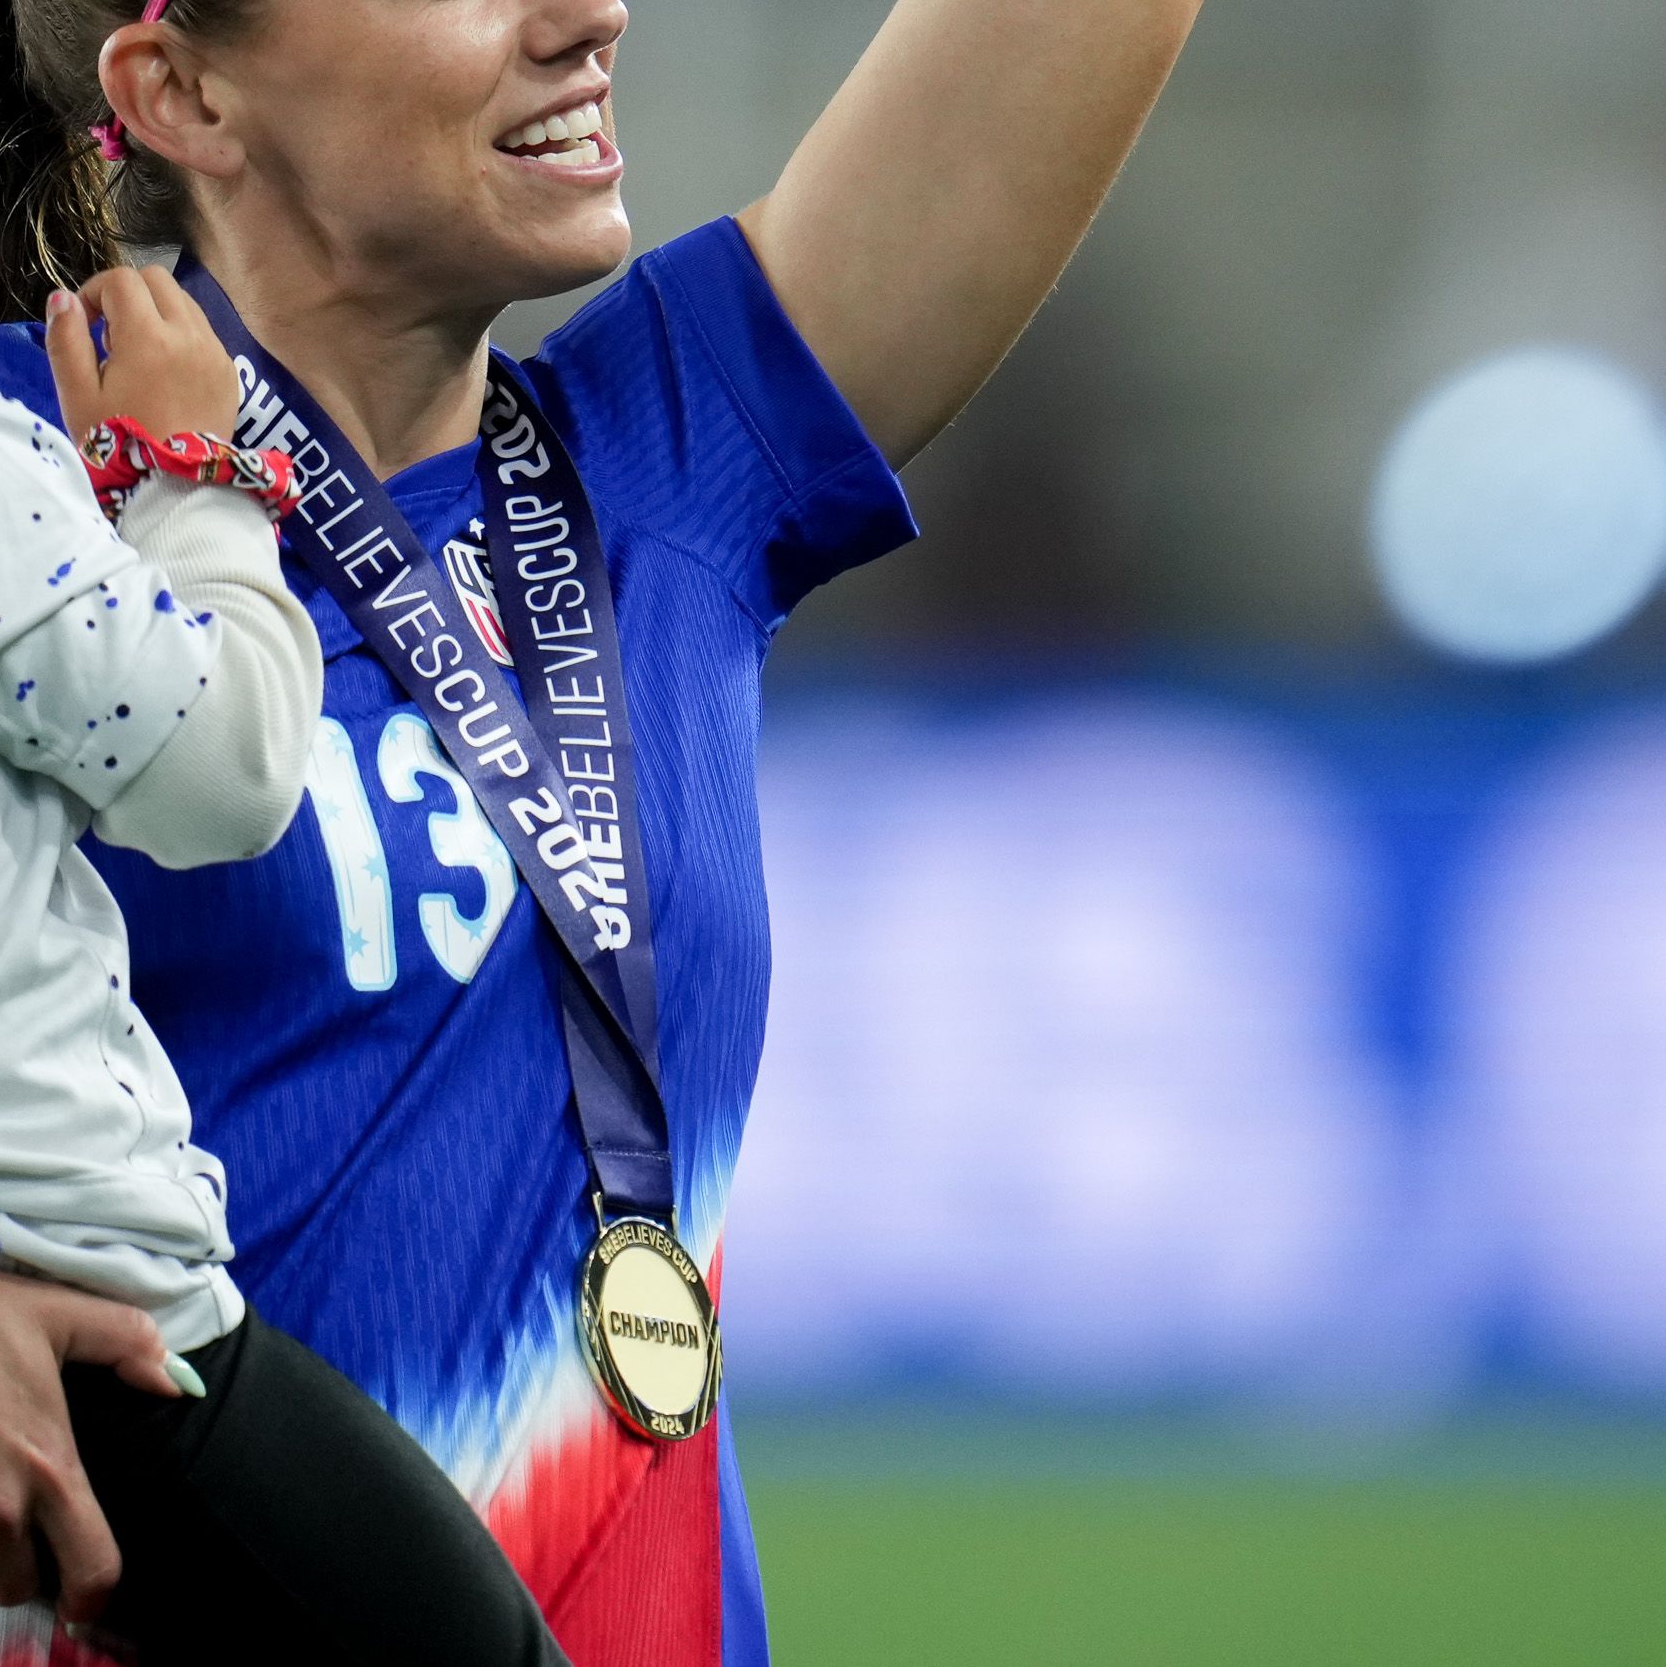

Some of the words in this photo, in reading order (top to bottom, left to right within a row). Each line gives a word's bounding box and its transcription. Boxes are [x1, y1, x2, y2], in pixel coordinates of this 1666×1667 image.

[482, 379, 551, 485] 202
[304, 712, 521, 993] 13
[598, 1223, 673, 1265] SHEBELIEVES
[672, 1248, 699, 1284] CUP
[609, 1310, 700, 1350] CHAMPION
[650, 1411, 685, 1435] 2024
